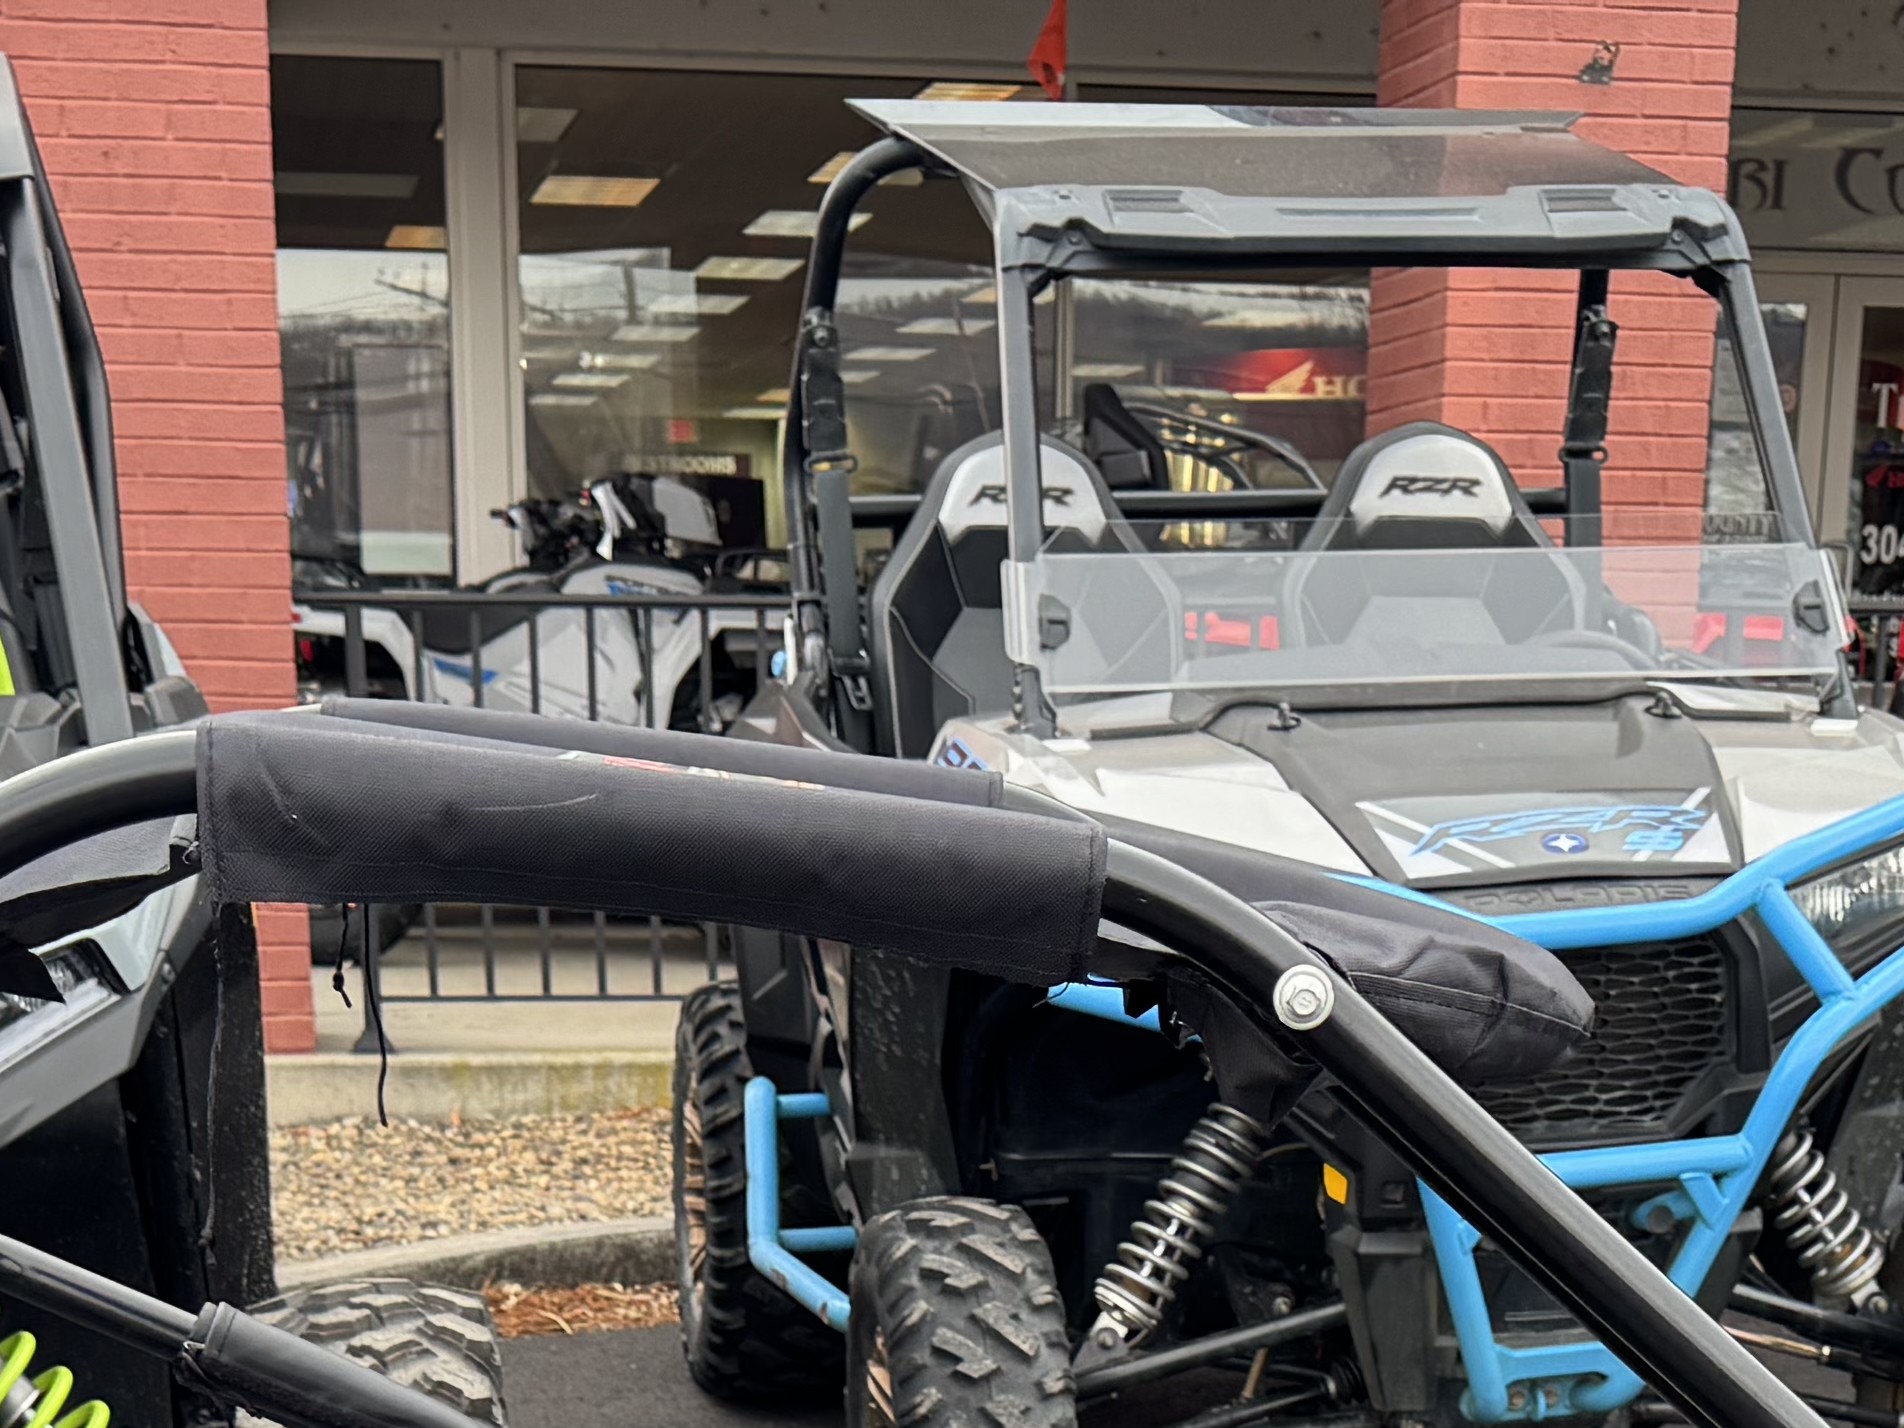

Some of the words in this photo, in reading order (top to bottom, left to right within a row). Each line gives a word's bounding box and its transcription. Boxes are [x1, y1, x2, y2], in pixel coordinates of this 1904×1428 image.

[1731, 155, 1787, 212] RI
[970, 484, 1075, 507] RR
[1379, 475, 1483, 499] RZR
